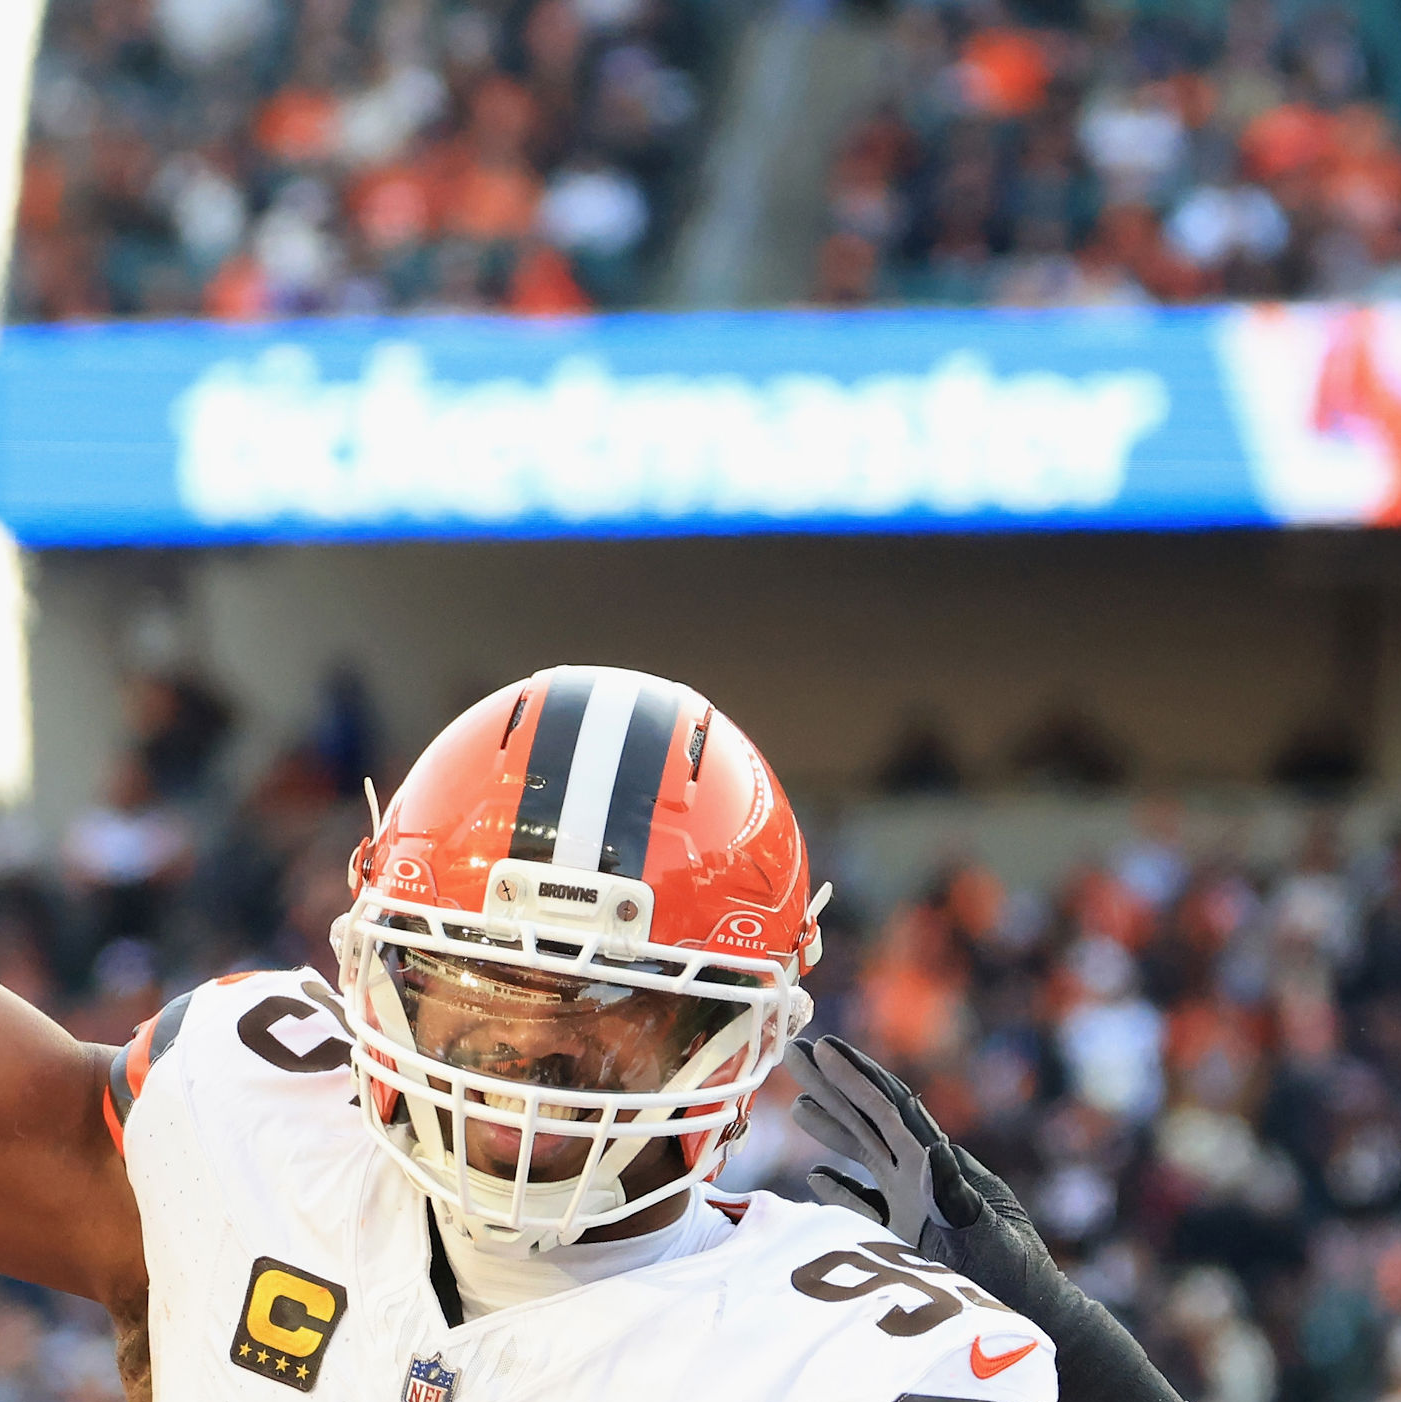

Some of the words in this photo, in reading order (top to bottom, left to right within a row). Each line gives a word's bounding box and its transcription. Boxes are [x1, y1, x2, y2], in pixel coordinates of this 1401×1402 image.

[538, 881, 599, 904] BROWNS
[716, 933, 768, 951] OAKLEY
[246, 1269, 336, 1358] C
